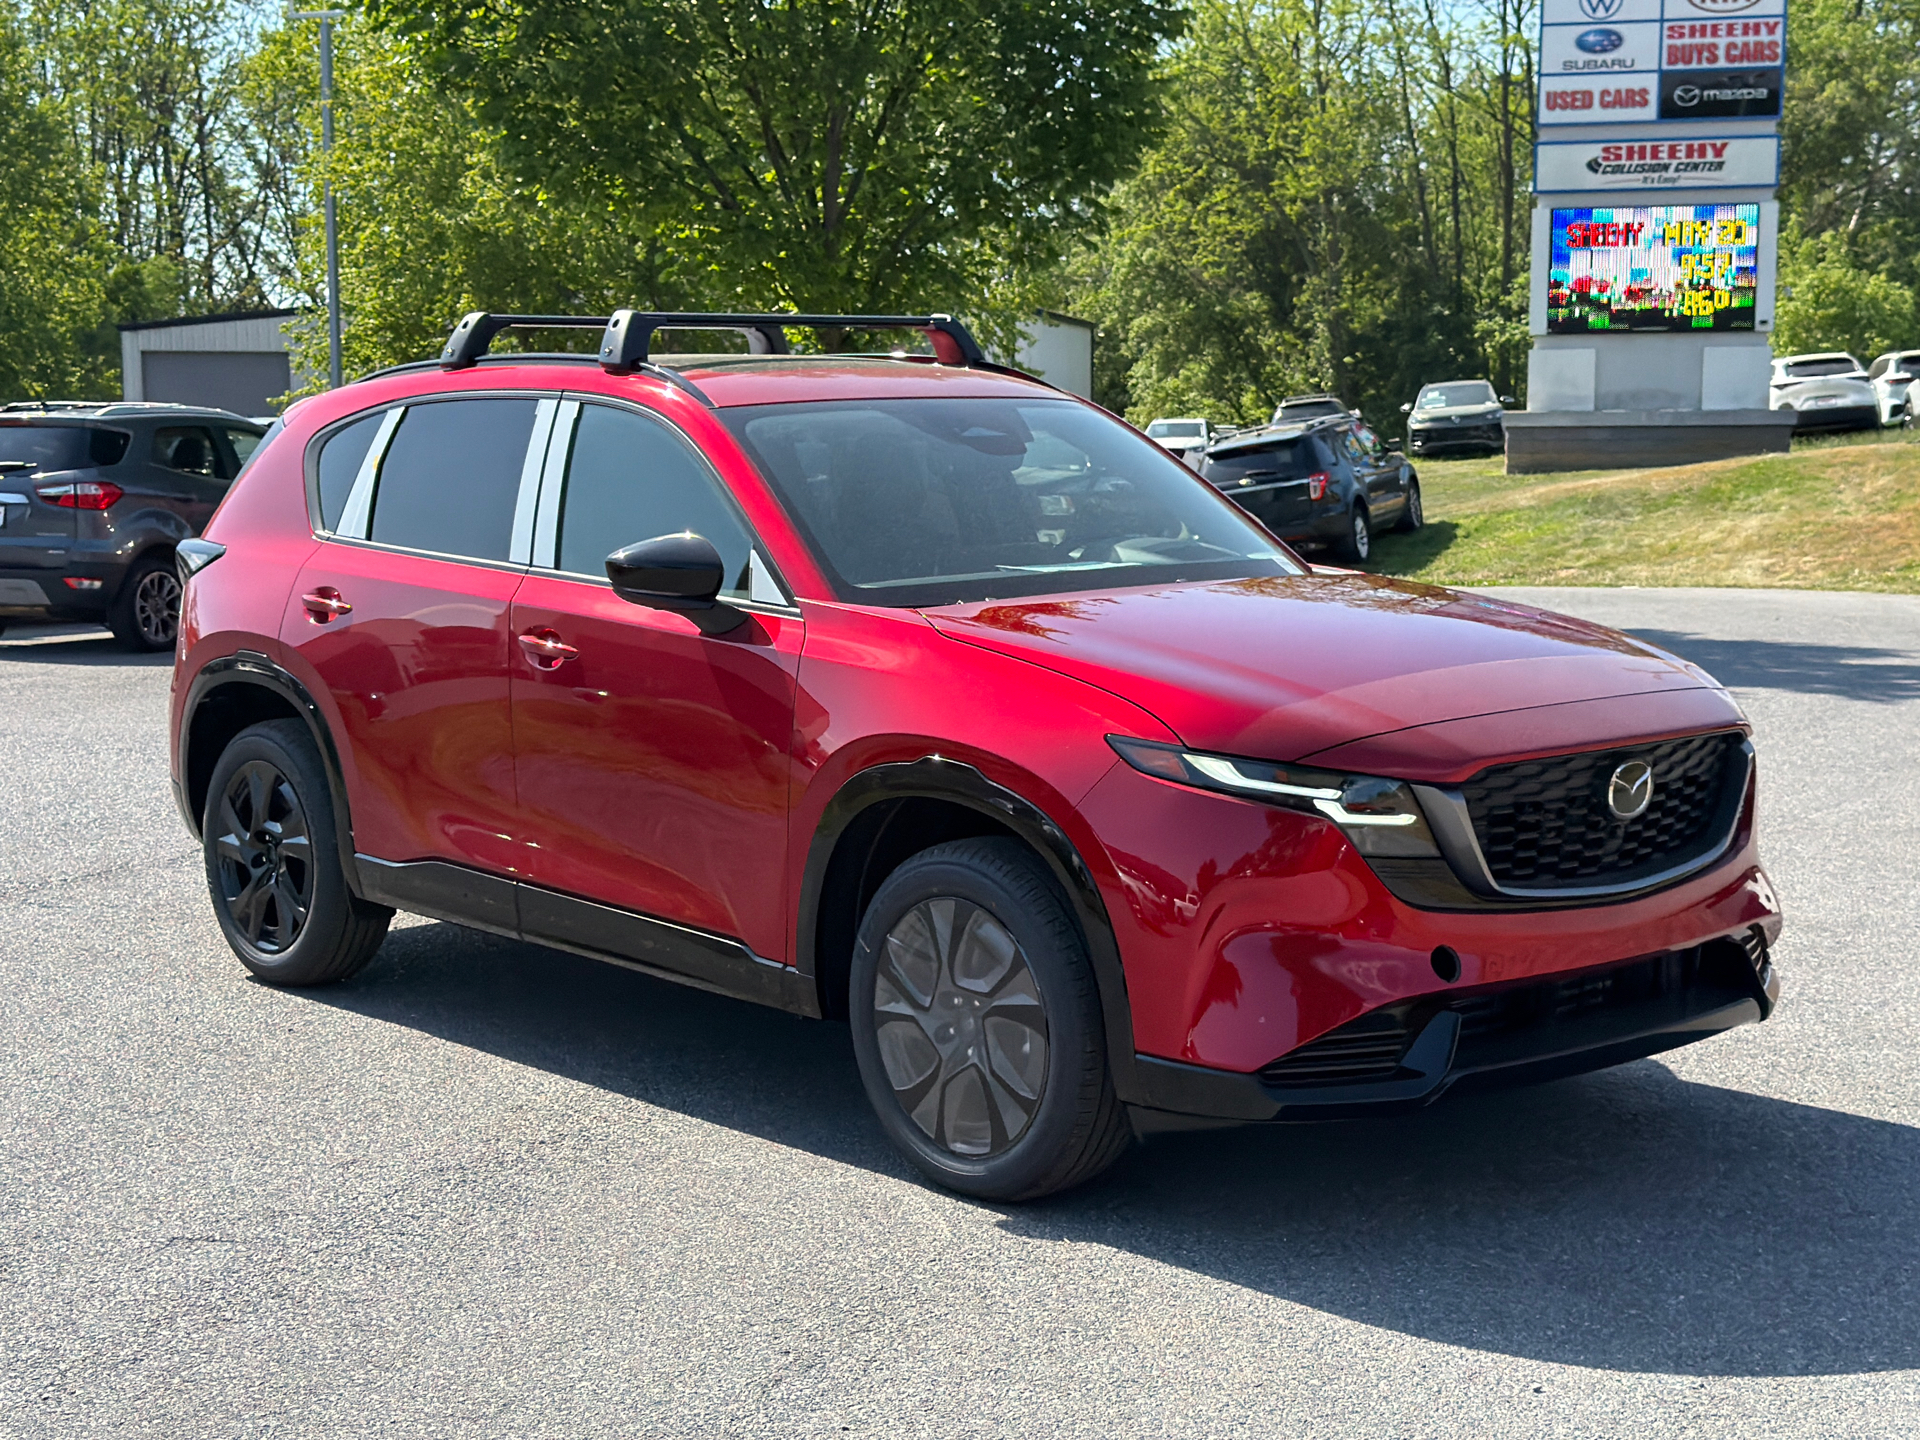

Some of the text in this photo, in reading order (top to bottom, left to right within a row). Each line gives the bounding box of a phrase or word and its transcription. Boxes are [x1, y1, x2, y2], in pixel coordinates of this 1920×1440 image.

[1666, 21, 1780, 40] SHEEHY
[1667, 40, 1780, 66] BUYS CARS
[1562, 58, 1635, 71] SUBARU
[1545, 87, 1650, 111] USED CARS
[1703, 87, 1768, 101] mazda
[1601, 142, 1729, 162] SHEEHY
[1601, 161, 1725, 175] COLLISION CENTER
